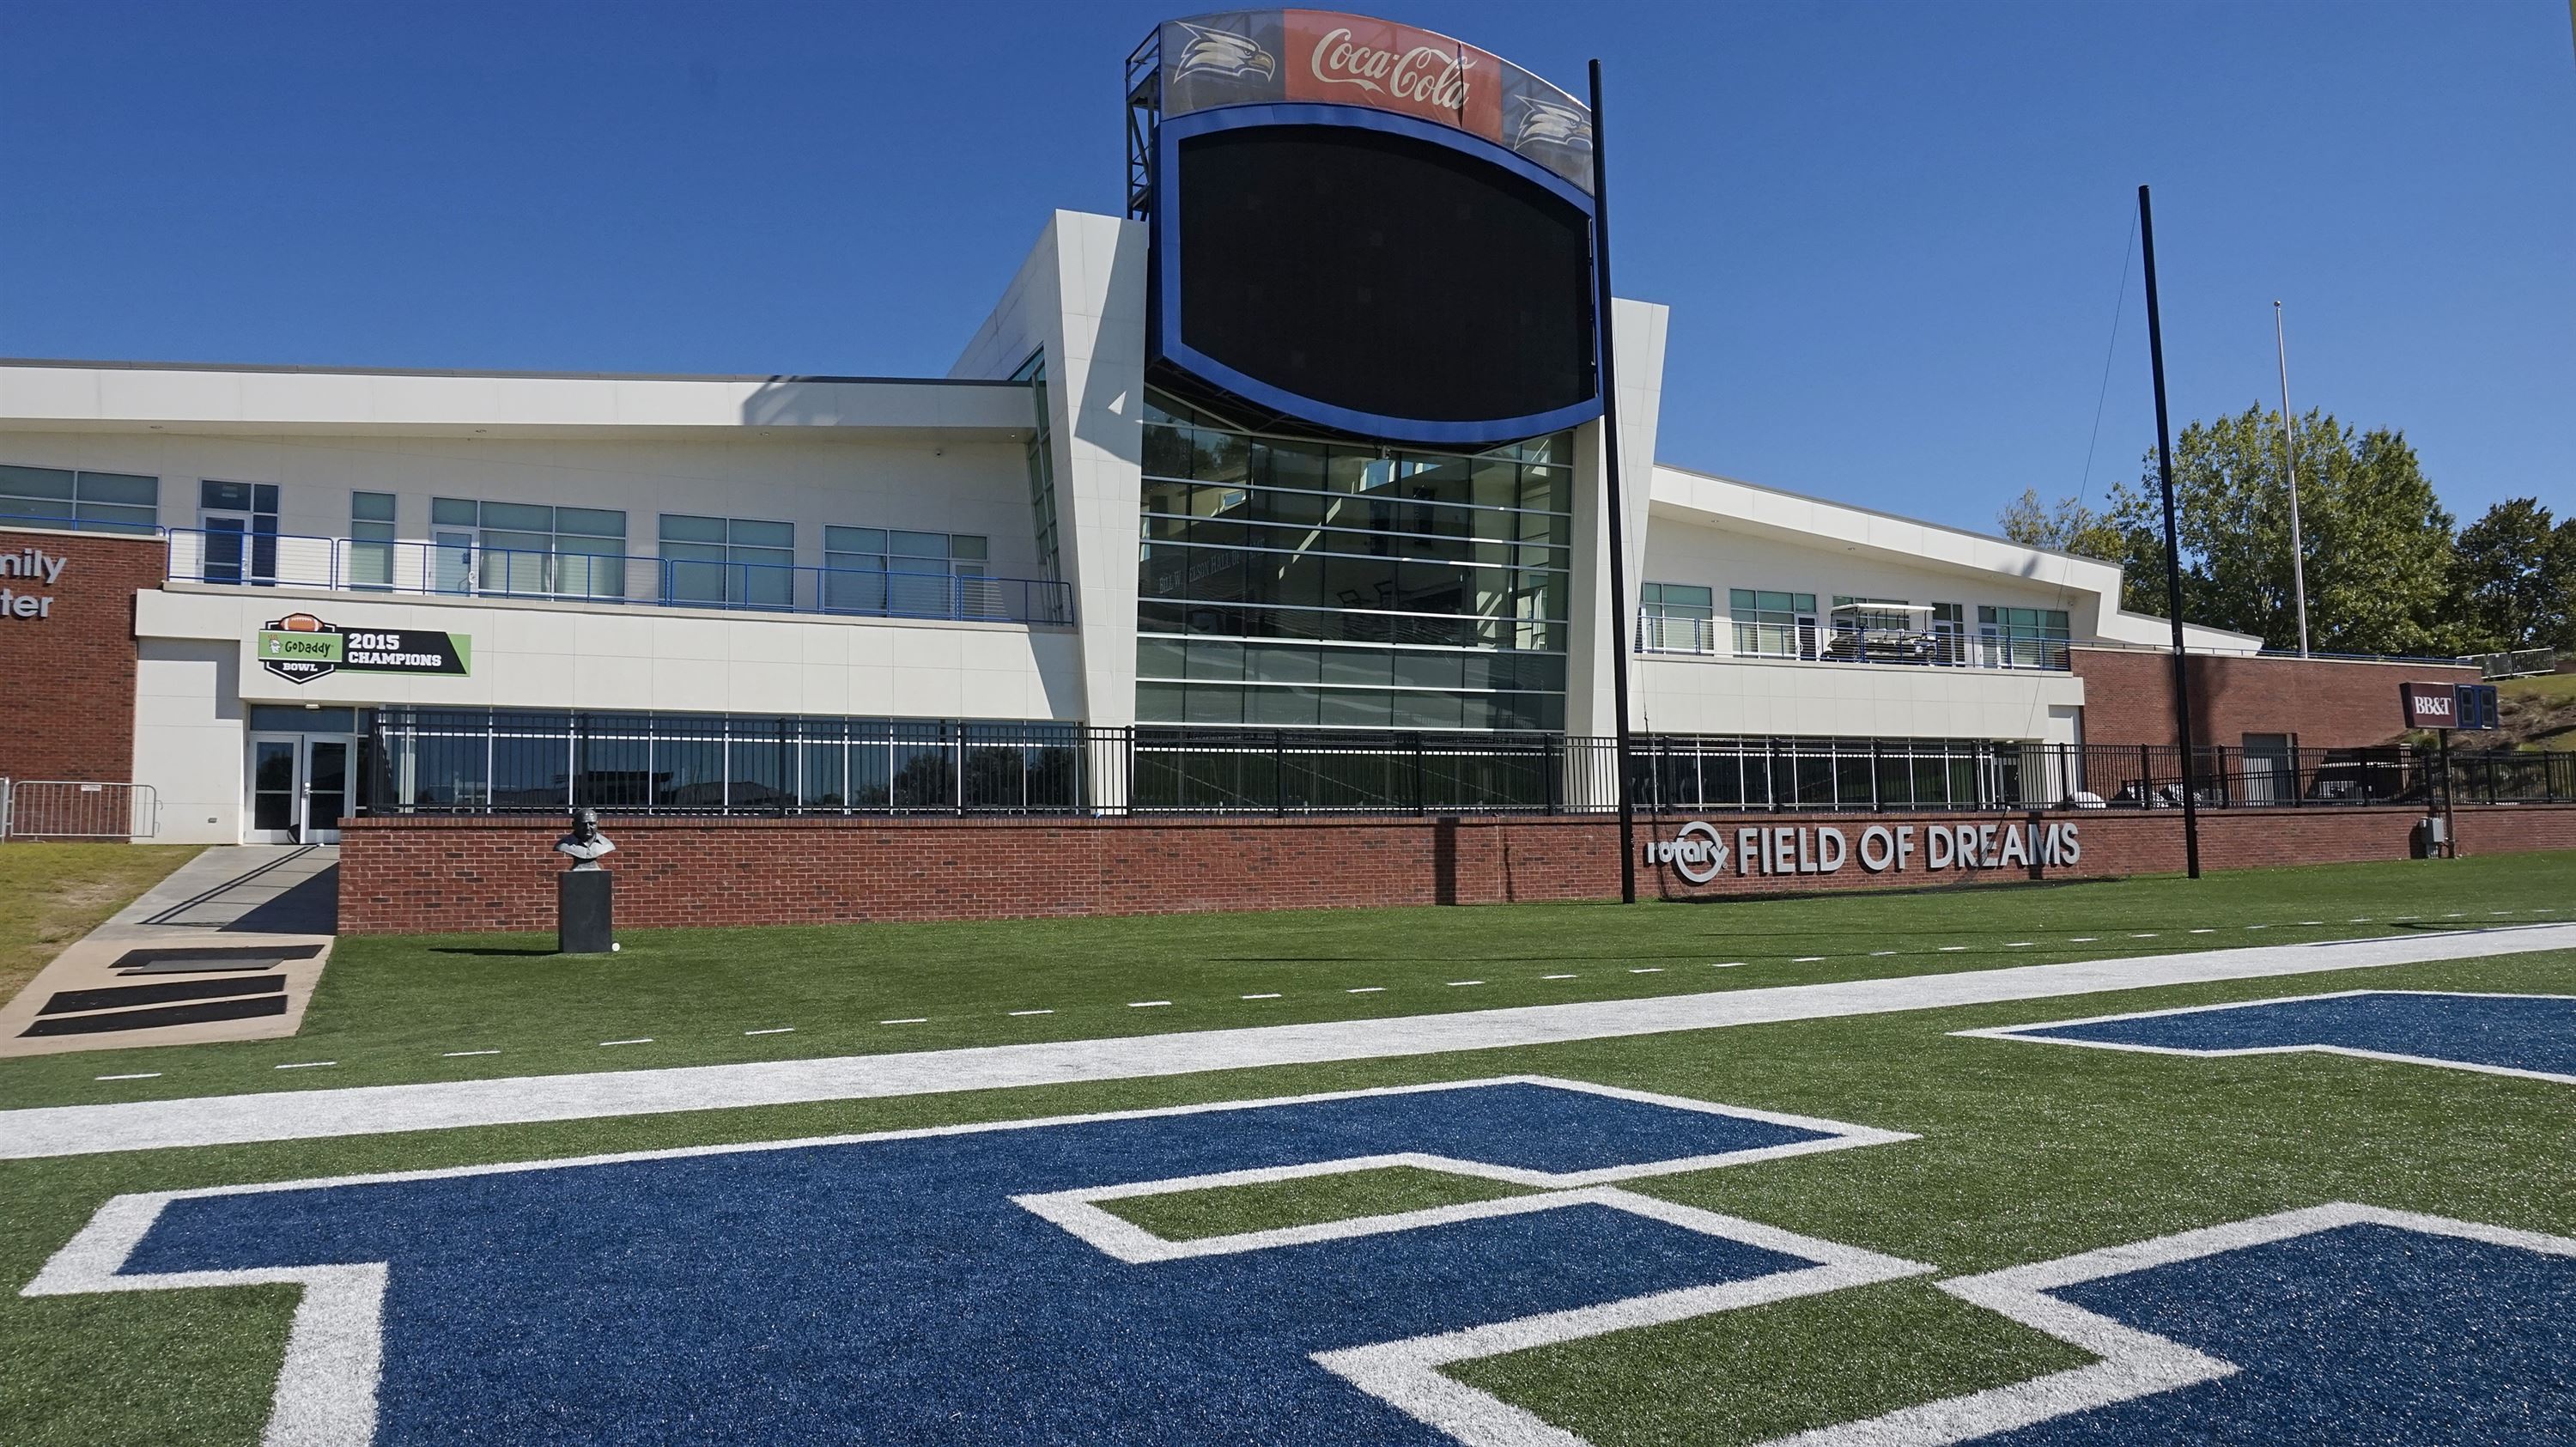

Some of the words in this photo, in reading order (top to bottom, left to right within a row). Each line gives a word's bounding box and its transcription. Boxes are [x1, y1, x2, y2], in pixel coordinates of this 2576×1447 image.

[1311, 28, 1477, 110] Coca-Cola
[1188, 560, 1210, 583] ELSON
[1211, 553, 1230, 574] HALL
[285, 641, 332, 658] GoDaddy
[349, 633, 400, 650] 2015
[283, 662, 319, 672] BOWL
[348, 651, 442, 666] CHAMPIONS
[2414, 696, 2451, 715] BB&T
[1648, 831, 1729, 872] rotary
[1739, 827, 1846, 874] FIELD
[1860, 825, 1914, 871] OF
[1929, 823, 2081, 868] DREAMS
